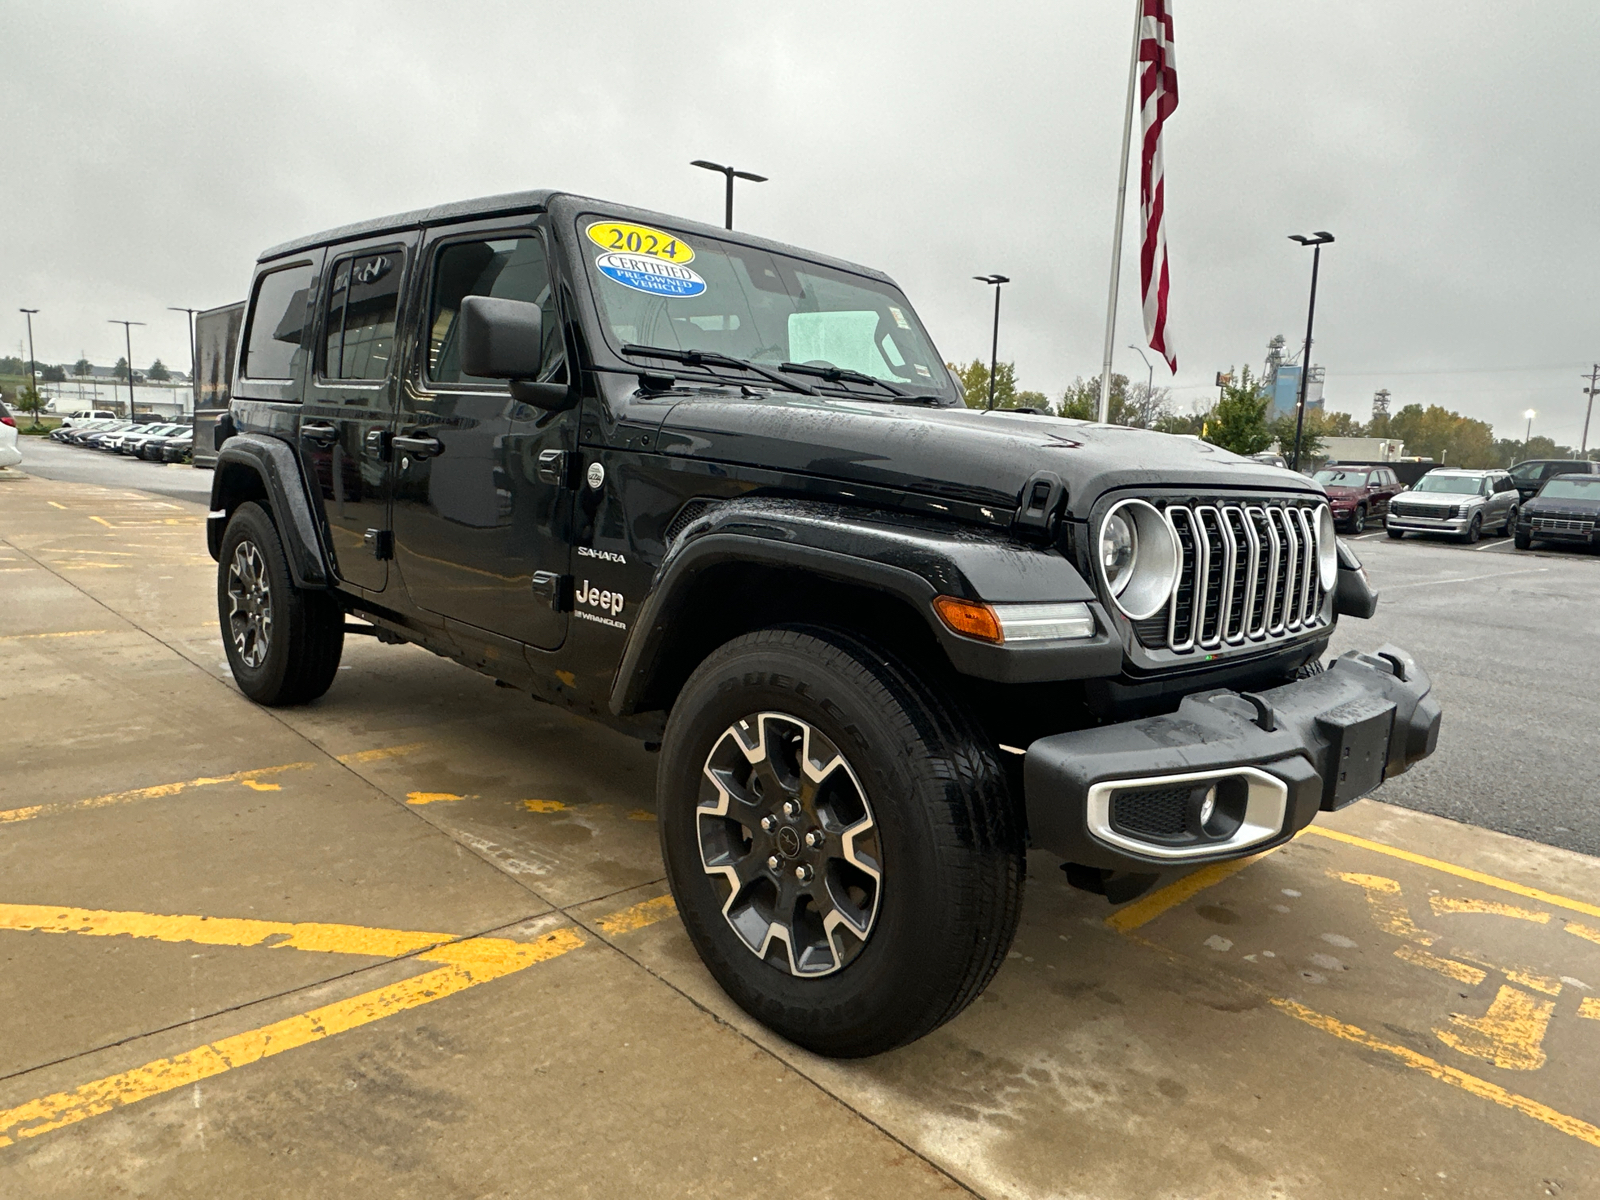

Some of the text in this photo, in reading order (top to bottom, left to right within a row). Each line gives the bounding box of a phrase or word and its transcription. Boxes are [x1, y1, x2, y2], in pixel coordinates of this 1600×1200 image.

[608, 228, 678, 259] 2024
[607, 255, 693, 280] CERTIFIED
[616, 269, 693, 289] PRE-OWNED
[630, 278, 686, 294] VEHICLE
[577, 546, 627, 564] SAHARA
[575, 579, 624, 616] Jeep
[582, 611, 627, 630] WRANGLER
